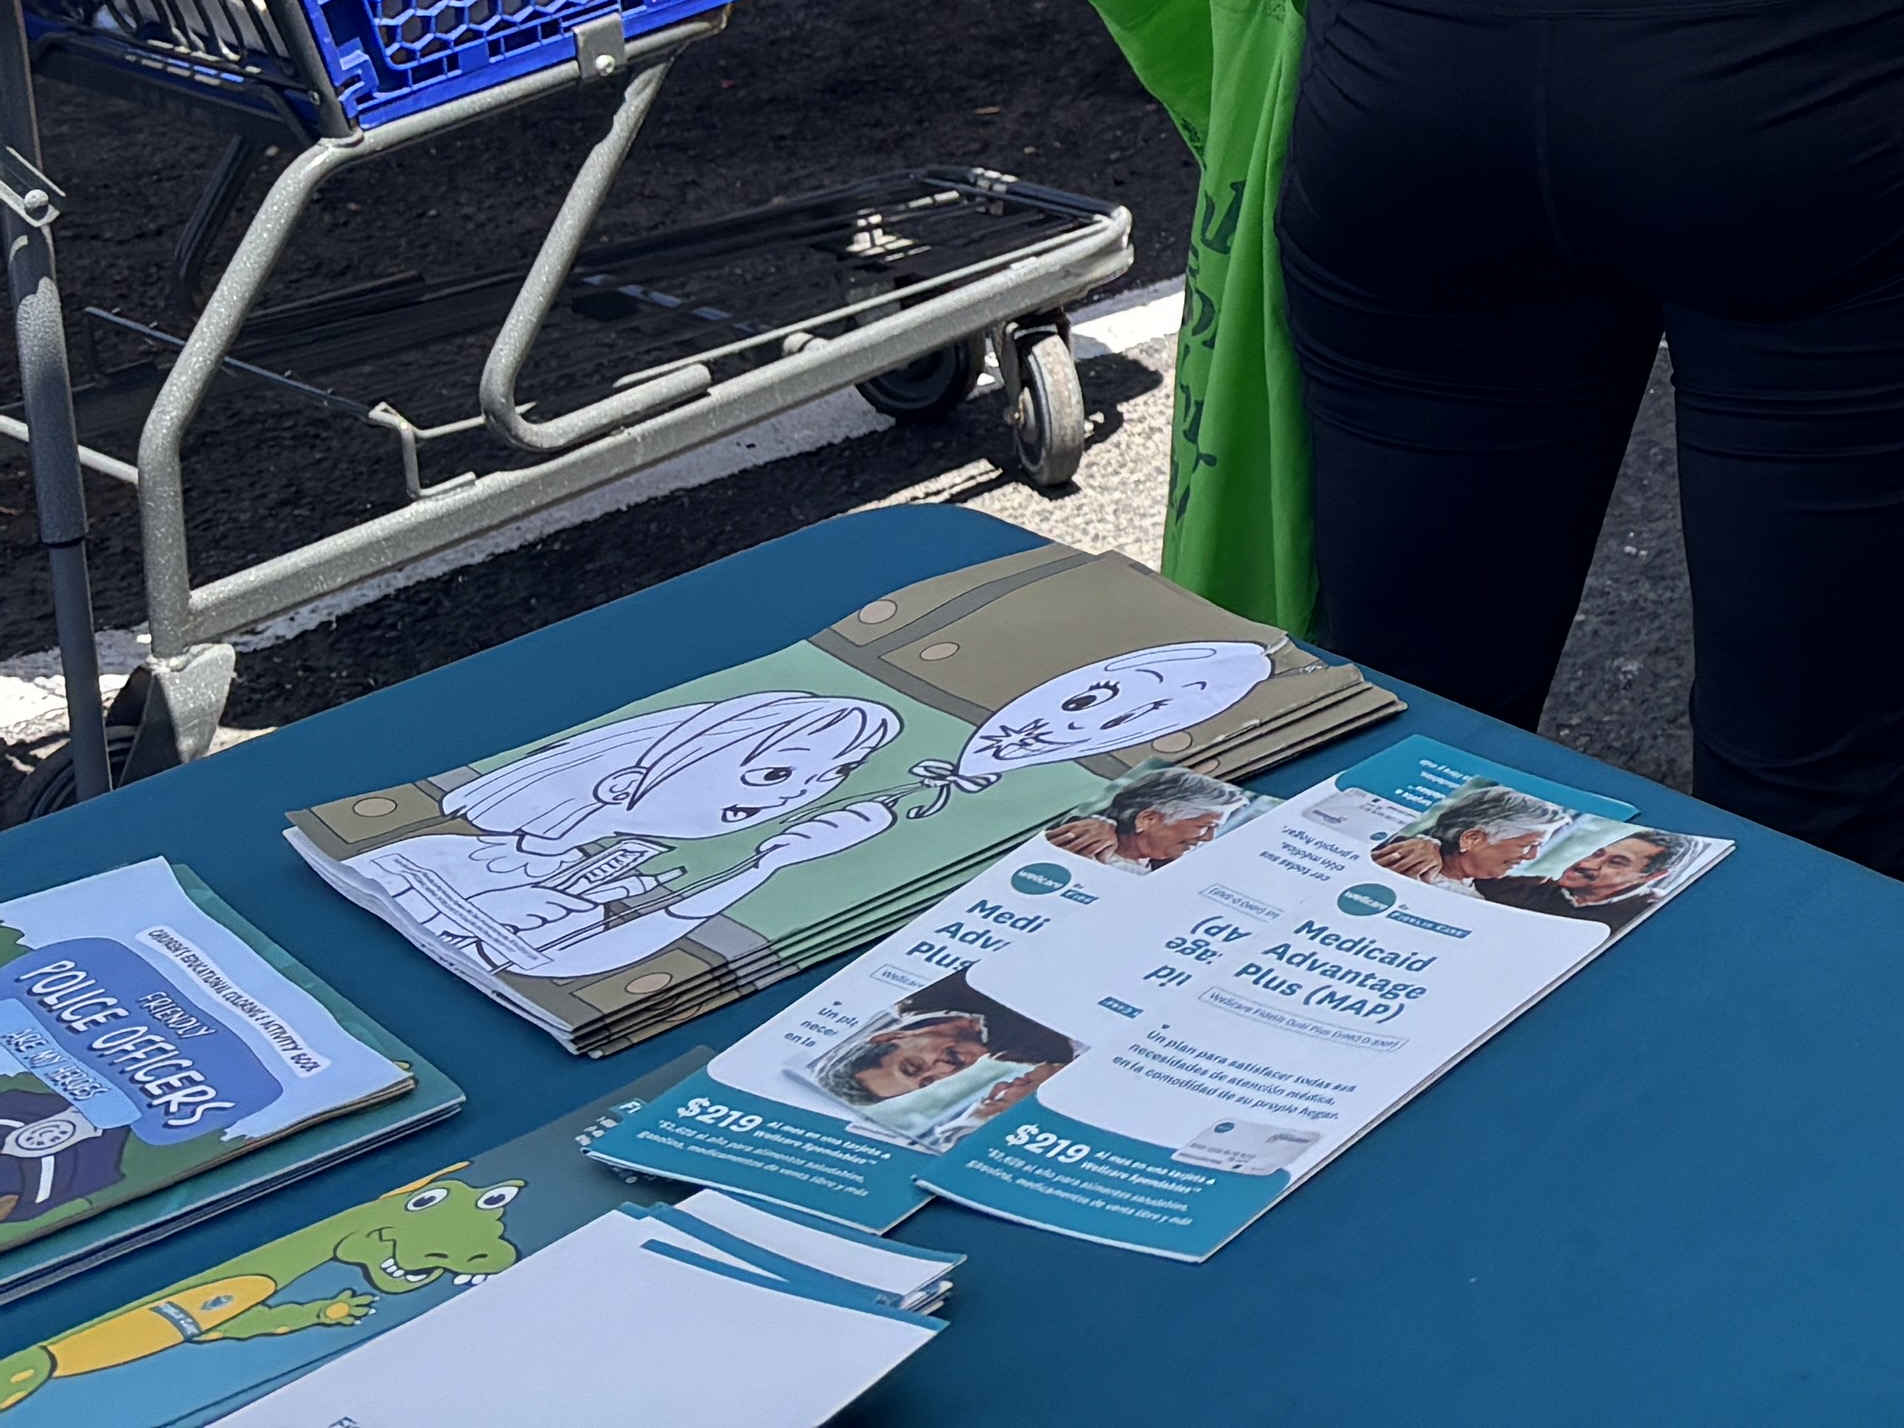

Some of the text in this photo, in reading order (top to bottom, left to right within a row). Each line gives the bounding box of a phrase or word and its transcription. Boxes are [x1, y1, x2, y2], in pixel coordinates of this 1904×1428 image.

[966, 899, 1051, 934] Medi
[1191, 915, 1253, 944] AP)
[1165, 936, 1224, 964] age
[1294, 919, 1437, 973] Medicaid
[1261, 942, 1428, 1001] Advantage
[1234, 962, 1406, 1025] Plus (MAP)
[138, 991, 217, 1041] FRIENDLY
[19, 959, 236, 1128] POLICE OFFICERS
[1111, 1057, 1131, 1065] en
[1126, 1045, 1212, 1074] necesidades
[1145, 1031, 1169, 1041] Un
[1164, 1039, 1200, 1053] plan
[1195, 1051, 1228, 1064] para
[676, 1096, 764, 1134] $219
[1005, 1122, 1091, 1165] $219
